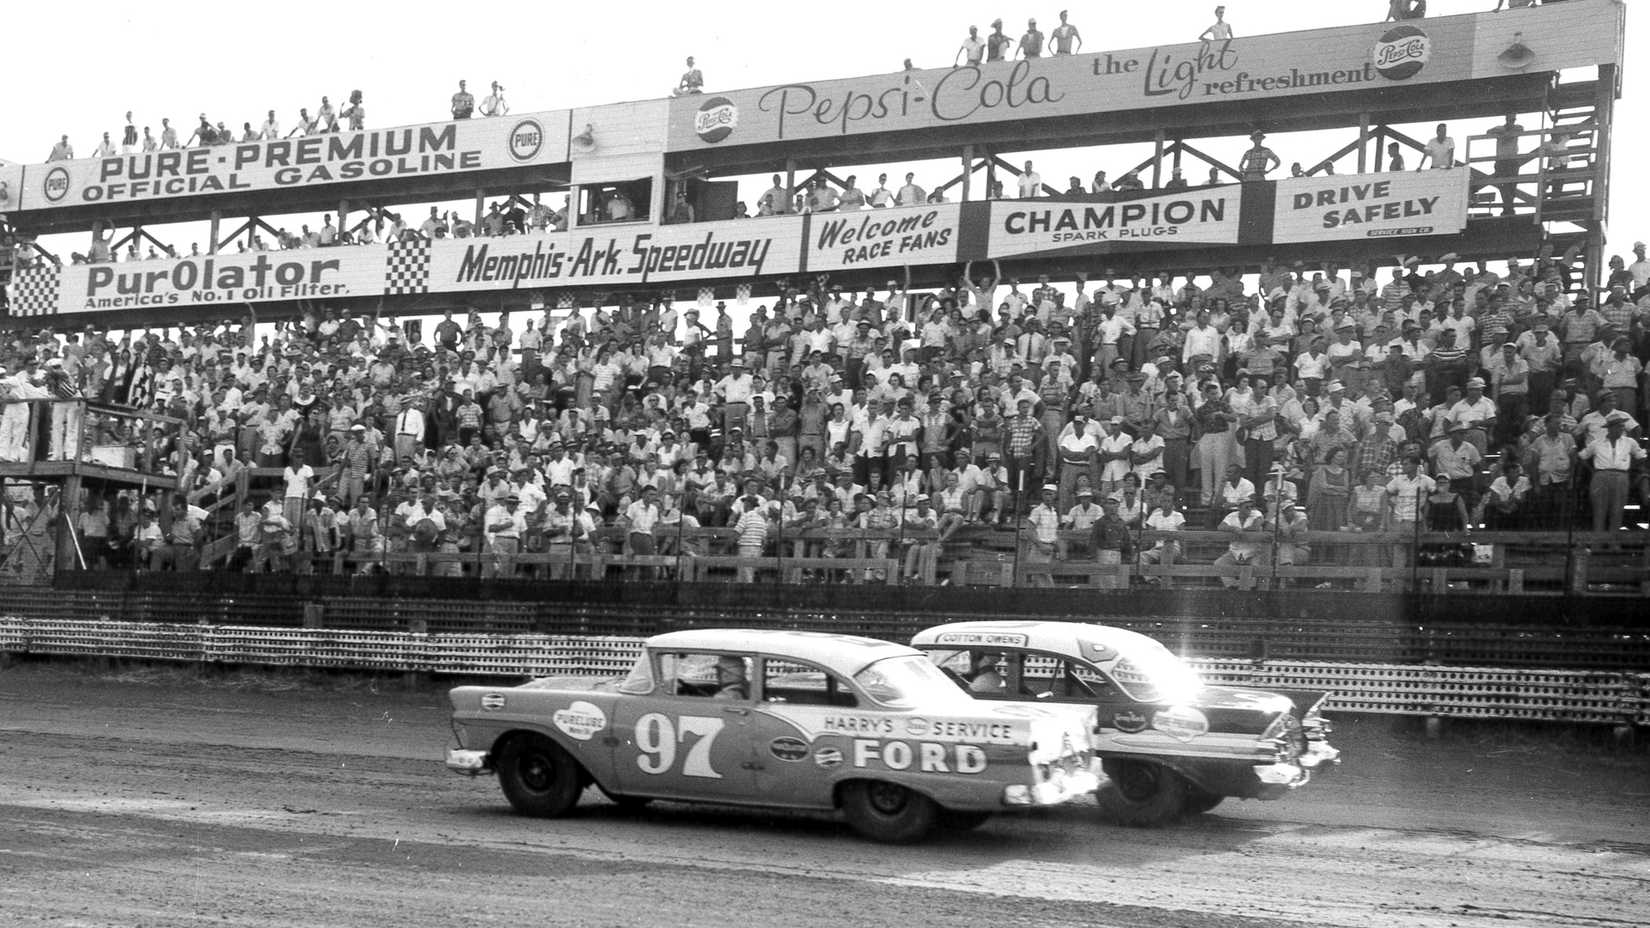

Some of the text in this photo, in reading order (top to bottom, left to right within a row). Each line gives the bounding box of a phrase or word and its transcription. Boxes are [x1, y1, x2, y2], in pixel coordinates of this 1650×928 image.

[1091, 39, 1239, 100] the Light
[1202, 62, 1377, 96] refreshment
[757, 60, 1065, 139] Pepsi-Cola
[514, 131, 538, 148] PURE
[82, 150, 483, 202] OFFICIAL GASOLINE
[1293, 180, 1391, 210] DRIVE
[1322, 196, 1441, 229] SAFELY
[817, 210, 938, 250] Welcome
[1004, 198, 1226, 235] CHAMPION
[1051, 226, 1178, 243] SPARK PLUGS
[627, 231, 773, 283] Speedway
[842, 228, 952, 265] RACE FANS
[84, 291, 179, 309] America's
[242, 284, 273, 300] Oil
[943, 633, 1022, 645] COTTON OWENS
[634, 712, 725, 779] 97
[824, 716, 893, 733] HARRY'S
[933, 721, 1013, 739] SERVICE
[853, 738, 988, 774] FORD
